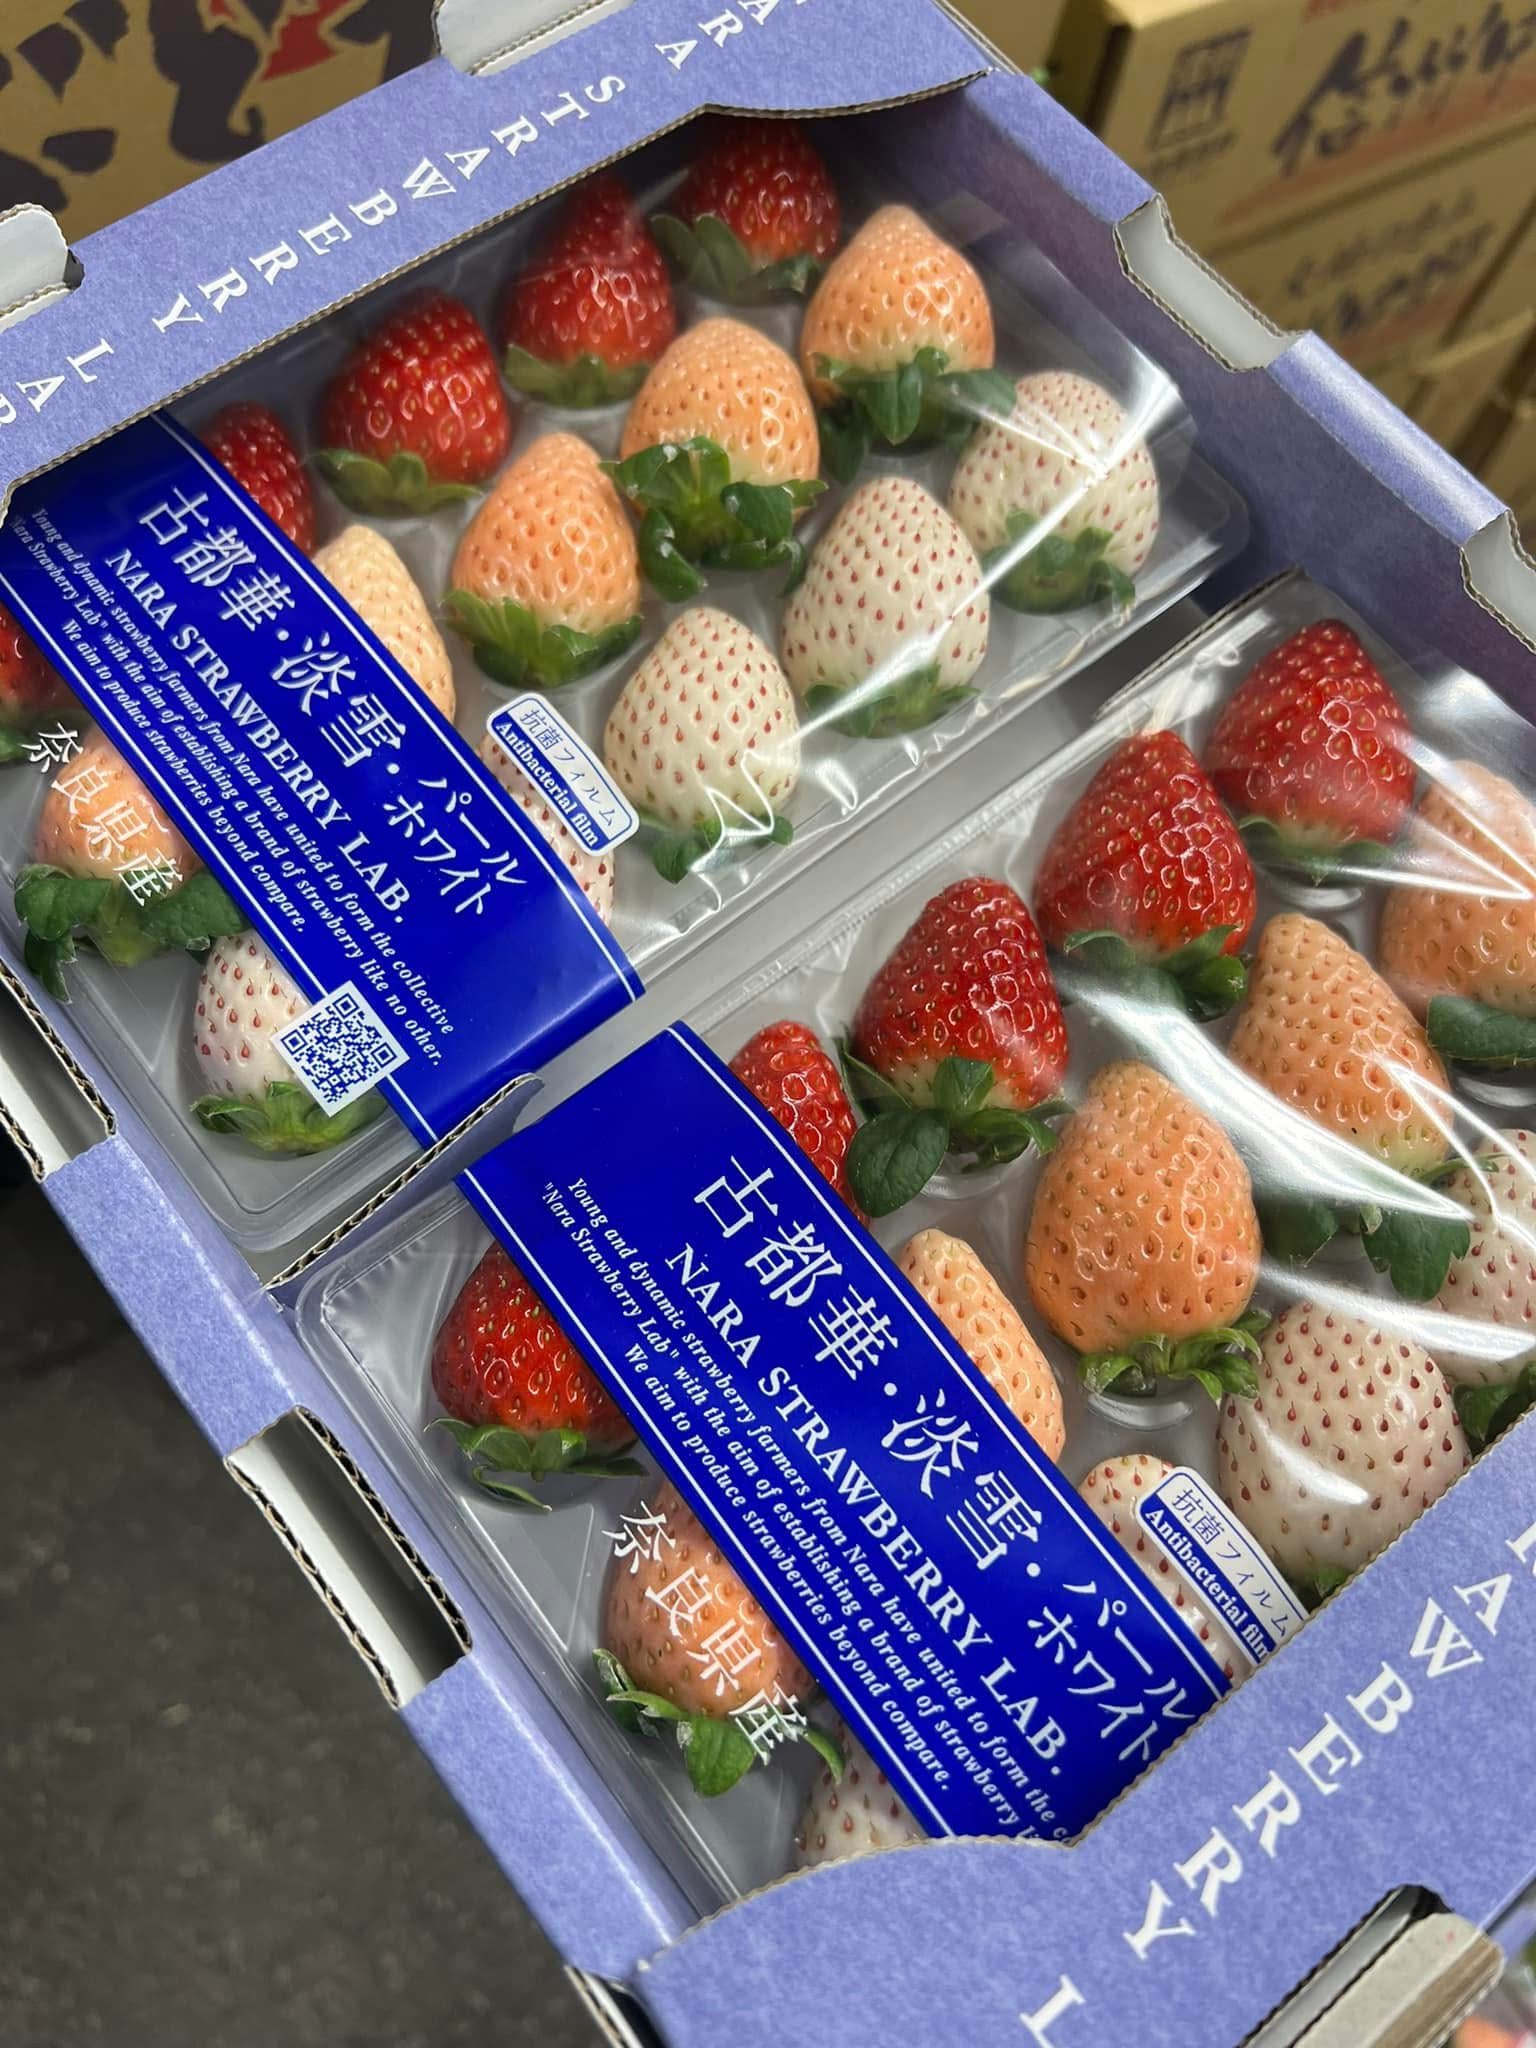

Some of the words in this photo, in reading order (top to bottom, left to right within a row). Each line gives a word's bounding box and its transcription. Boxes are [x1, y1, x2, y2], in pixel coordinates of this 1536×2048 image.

[654, 0, 806, 70] ARA
[151, 75, 626, 333] STRAWBERRY
[56, 541, 85, 563] and
[72, 561, 116, 607] dynamic
[61, 618, 83, 642] We
[75, 641, 102, 667] aim
[109, 605, 169, 673] strawberry
[94, 664, 113, 681] to
[102, 680, 152, 729] produce
[158, 670, 210, 723] farmers
[104, 548, 178, 631] NARA
[171, 625, 352, 830] STRAWBERRY
[337, 831, 411, 924] LAB.
[144, 729, 213, 807] strawberries
[196, 720, 236, 755] from
[227, 751, 263, 788] Nara
[519, 708, 616, 827] 抗菌フィルム
[20, 722, 183, 907] 奈良県産
[27, 541, 80, 601] Strawberry
[101, 632, 132, 663] with
[121, 660, 147, 684] the
[139, 683, 167, 710] aim
[158, 708, 185, 725] of
[172, 723, 240, 801] establishing
[233, 799, 250, 813] a
[243, 809, 290, 859] brand
[280, 860, 307, 879] of
[295, 879, 365, 959] strawberry
[358, 957, 390, 993] like
[384, 993, 408, 1016] no
[403, 1019, 443, 1067] other.
[254, 784, 290, 822] have
[495, 722, 578, 819] Antibacterial
[570, 812, 600, 847] film
[207, 805, 260, 863] beyond
[284, 822, 335, 874] united
[250, 864, 306, 933] compare.
[323, 873, 344, 892] to
[333, 892, 376, 933] form
[369, 931, 397, 958] the
[391, 960, 455, 1035] collective
[567, 1177, 609, 1229] Young
[603, 1228, 639, 1260] and
[628, 1261, 687, 1330] dynamic
[681, 1332, 757, 1424] strawberry
[745, 1424, 811, 1497] farmers
[800, 1497, 848, 1547] from
[841, 1543, 886, 1597] Nara
[880, 1595, 922, 1645] have
[917, 1646, 977, 1711] united
[966, 1711, 989, 1734] to
[978, 1735, 1030, 1788] form
[1024, 1788, 1056, 1822] the
[569, 1227, 643, 1317] Strawberry
[672, 1365, 710, 1406] with
[702, 1406, 732, 1438] the
[726, 1440, 760, 1477] aim
[755, 1478, 784, 1500] of
[772, 1502, 863, 1617] establishing
[857, 1617, 875, 1633] a
[869, 1629, 926, 1693] brand
[915, 1695, 946, 1718] of
[933, 1719, 1020, 1825] strawberry
[664, 1242, 762, 1369] NARA
[757, 1366, 993, 1656] STRAWBERRY
[979, 1657, 1066, 1775] LAB.
[624, 1342, 649, 1374] We
[644, 1376, 677, 1412] aim
[670, 1410, 691, 1432] to
[682, 1433, 747, 1508] produce
[741, 1509, 833, 1626] strawberries
[828, 1623, 892, 1698] beyond
[881, 1699, 950, 1791] compare.
[1145, 1507, 1249, 1627] Antibacterial
[1171, 1488, 1289, 1638] 抗菌フィルム
[601, 1500, 807, 1767] 奈良県産
[1123, 1521, 1536, 1959] AWBERRY
